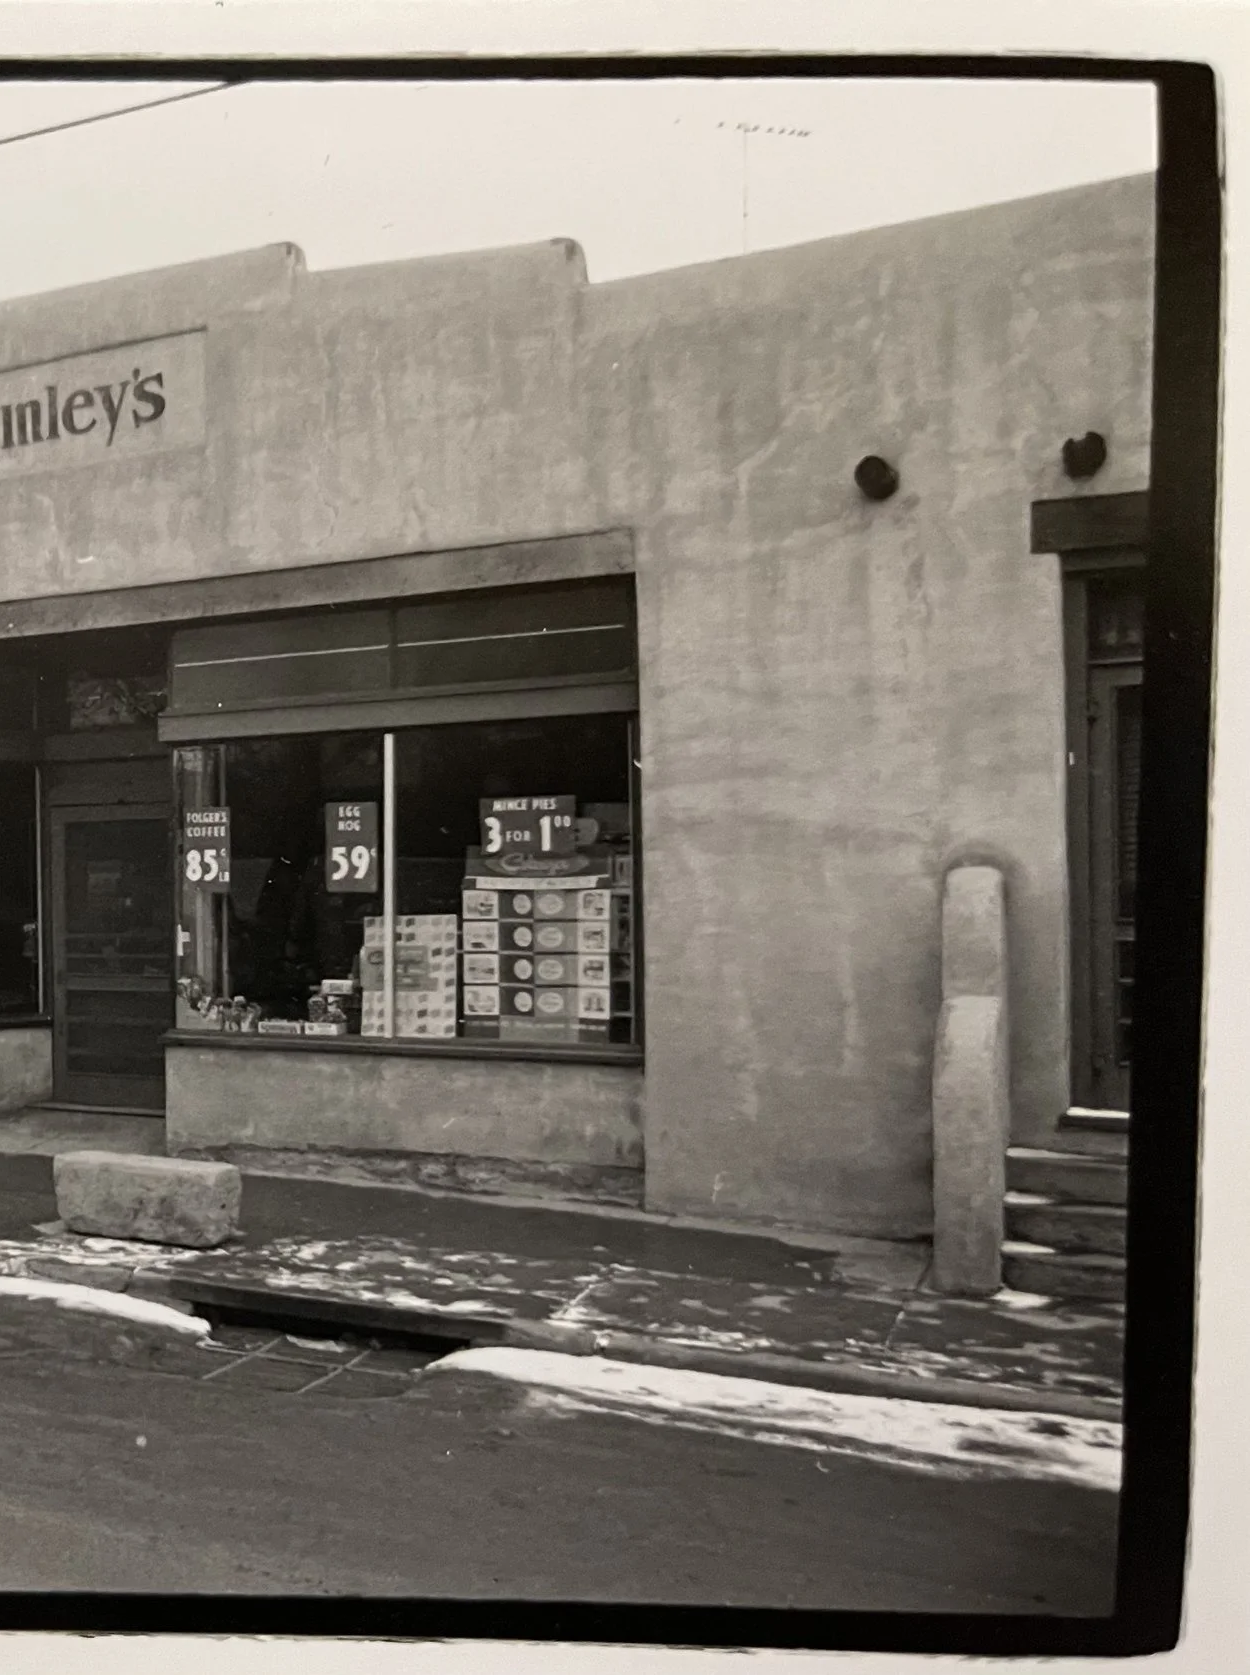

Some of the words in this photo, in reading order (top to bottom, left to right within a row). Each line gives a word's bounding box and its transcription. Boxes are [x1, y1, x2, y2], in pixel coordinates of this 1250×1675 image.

[492, 799, 527, 811] MINCE
[532, 798, 556, 810] PIES
[338, 806, 361, 818] EGG
[186, 826, 226, 837] COFFEE
[338, 820, 361, 832] NOG
[484, 816, 501, 853] 3
[505, 830, 530, 842] FOR
